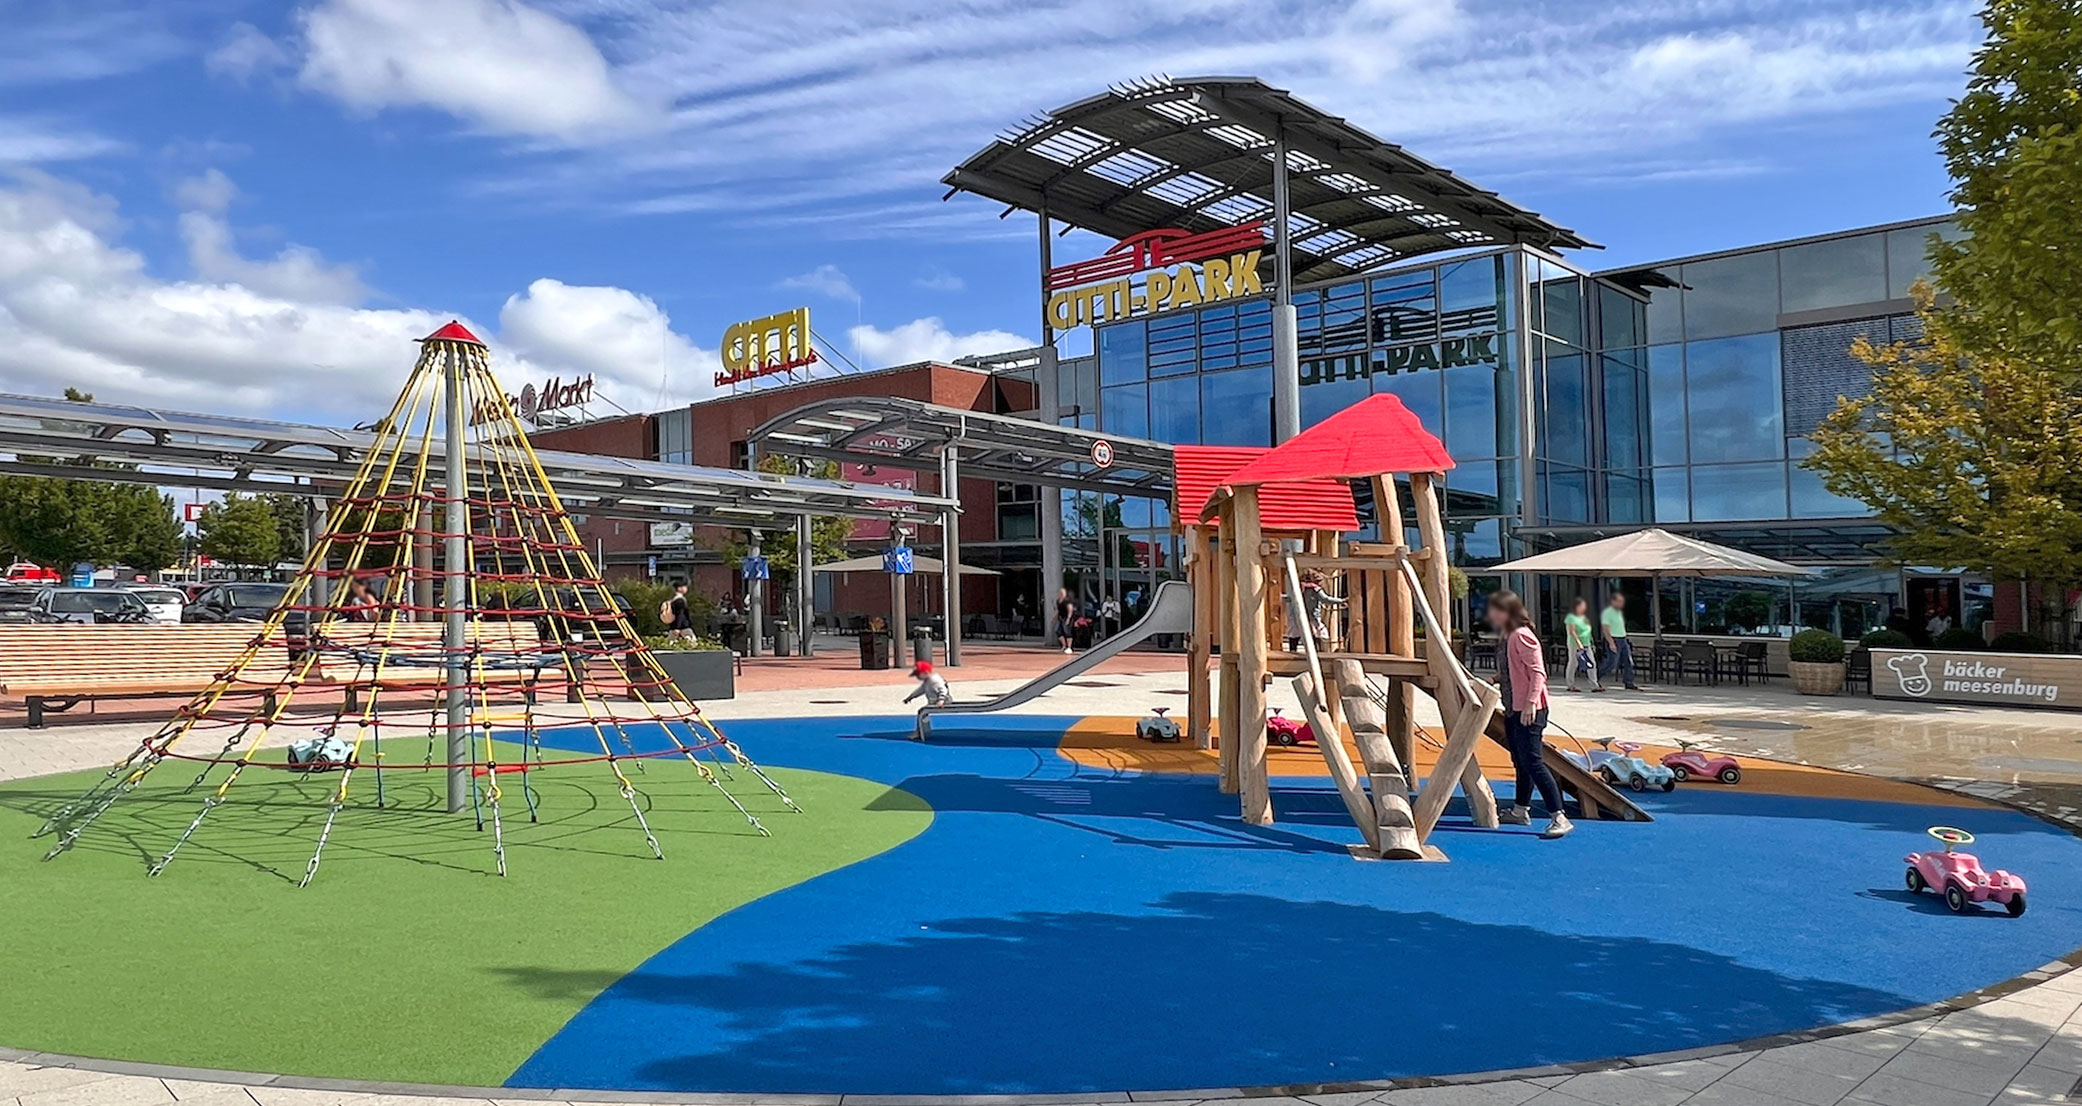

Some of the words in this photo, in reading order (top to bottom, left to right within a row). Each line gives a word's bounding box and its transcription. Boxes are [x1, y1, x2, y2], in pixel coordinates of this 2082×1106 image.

[1047, 249, 1263, 330] CITTI-PARK
[721, 306, 811, 377] CITTI
[536, 372, 594, 412] Markt
[1943, 660, 2006, 679] bäcker
[1943, 678, 2059, 702] meesenburg
